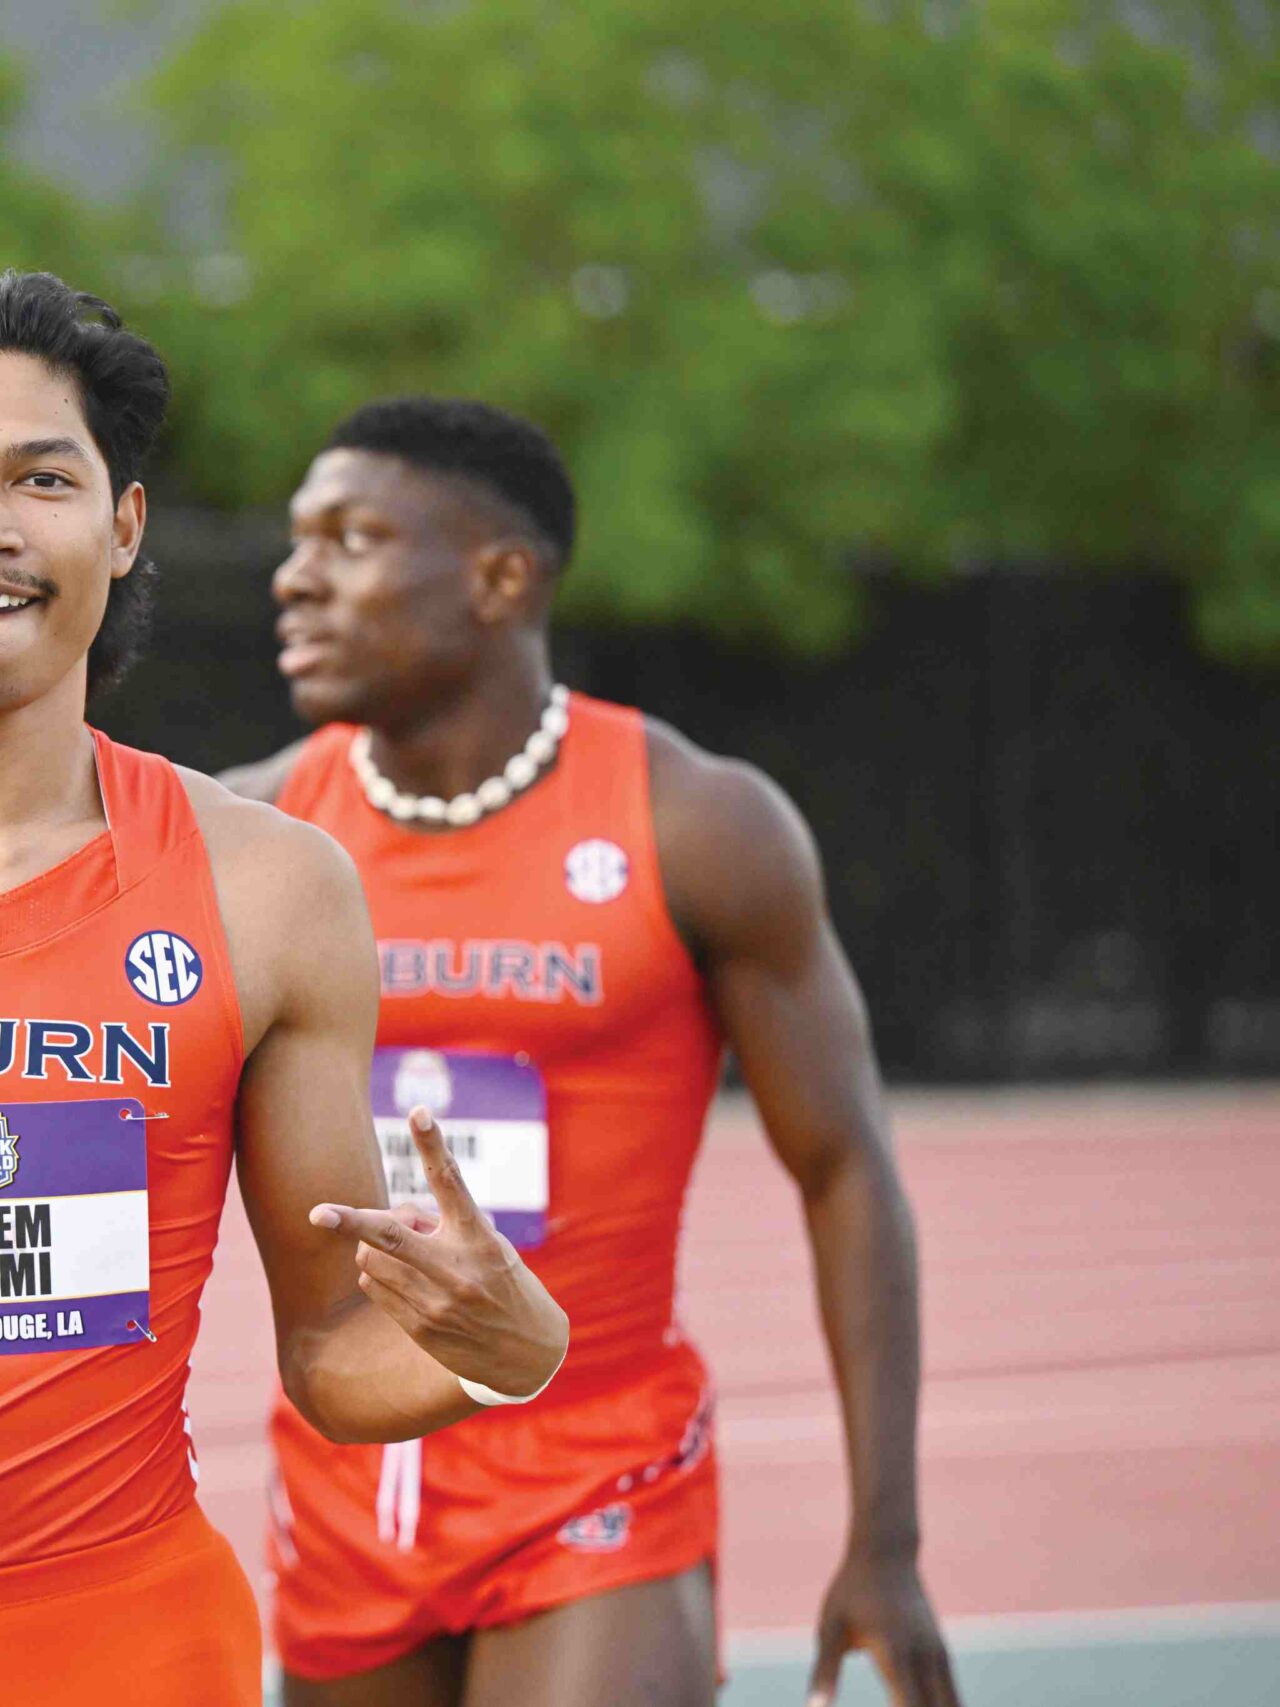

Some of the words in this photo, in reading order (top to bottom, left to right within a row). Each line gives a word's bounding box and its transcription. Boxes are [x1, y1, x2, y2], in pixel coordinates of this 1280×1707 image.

[128, 933, 199, 1003] SEC
[377, 939, 604, 1006] BURN
[56, 1310, 84, 1337] LA
